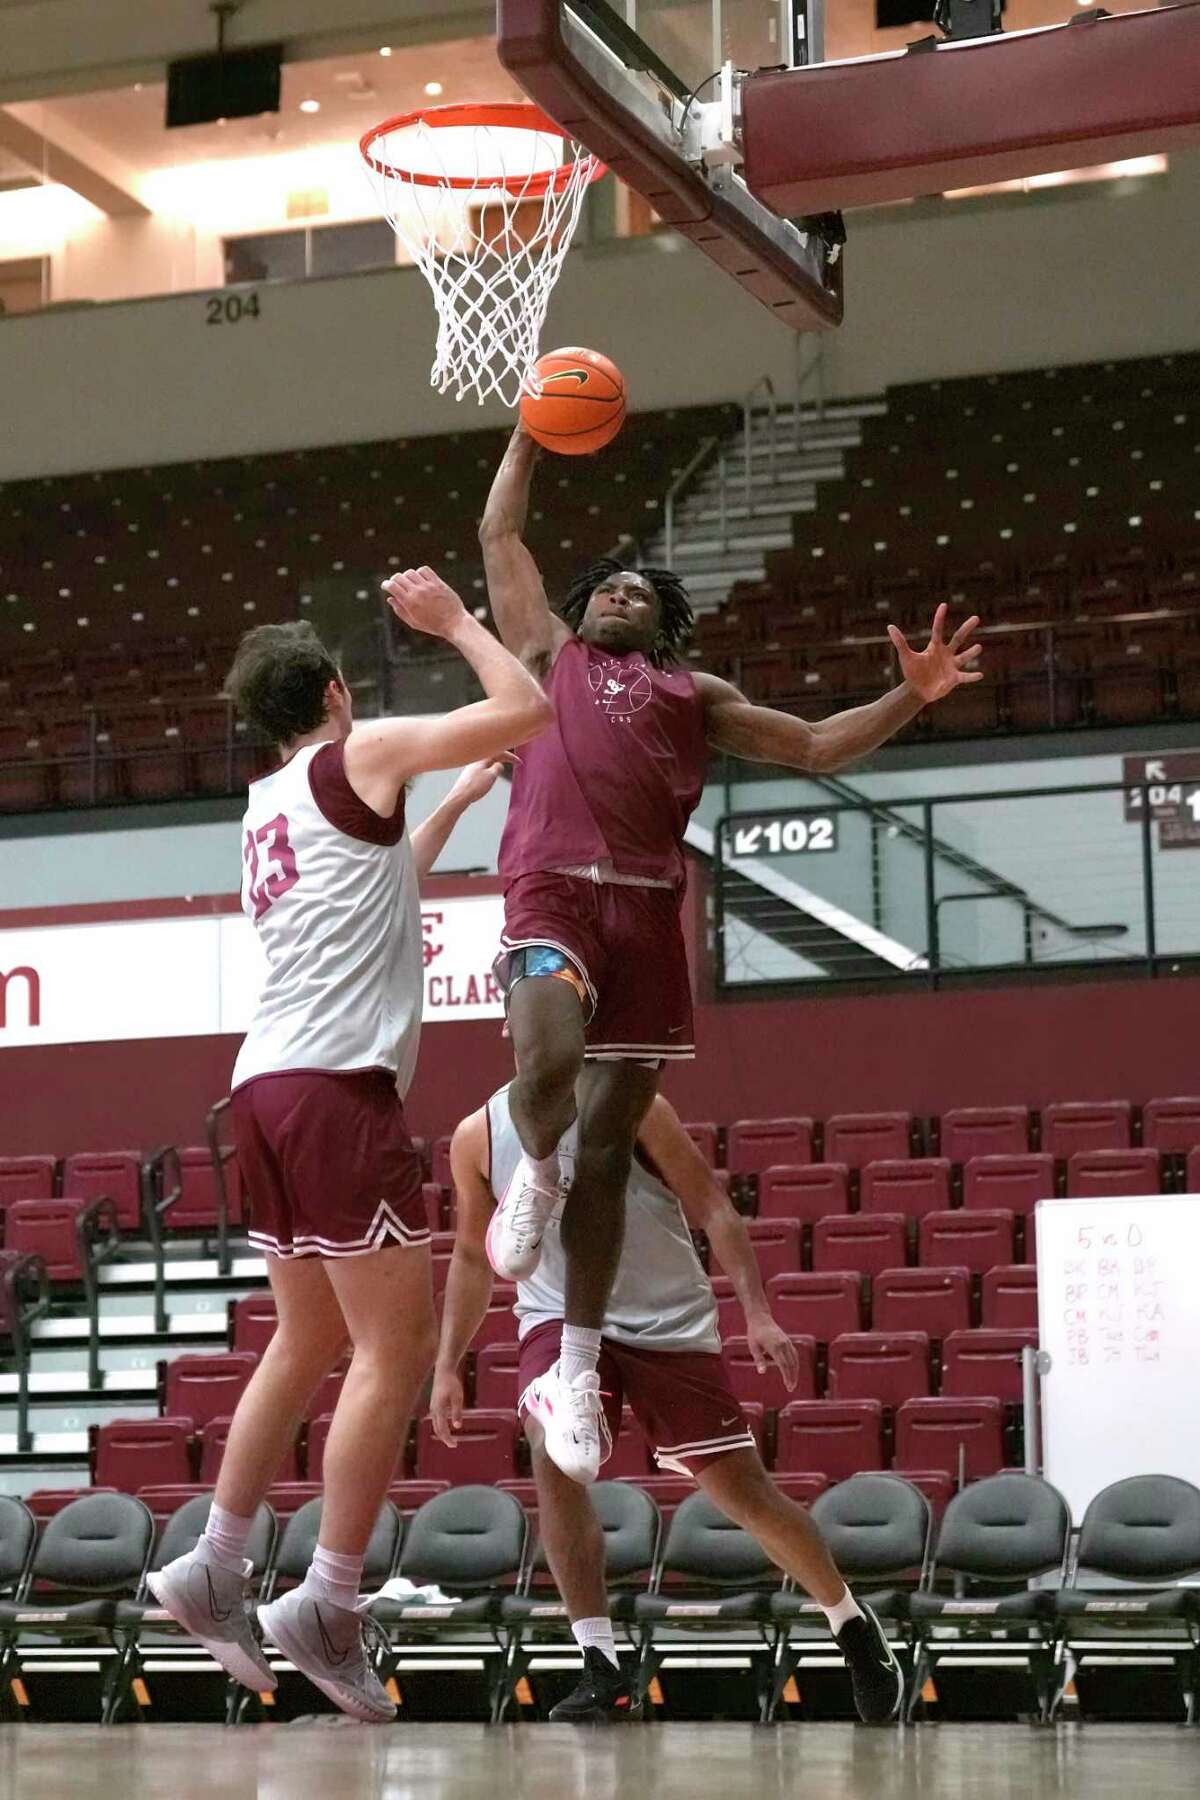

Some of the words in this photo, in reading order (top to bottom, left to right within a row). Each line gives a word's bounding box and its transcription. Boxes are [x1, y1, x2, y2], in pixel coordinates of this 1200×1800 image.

[206, 293, 260, 325] 204
[1130, 784, 1182, 807] 204
[763, 817, 834, 852] 102
[244, 813, 300, 920] 23
[1078, 1225, 1095, 1249] 5
